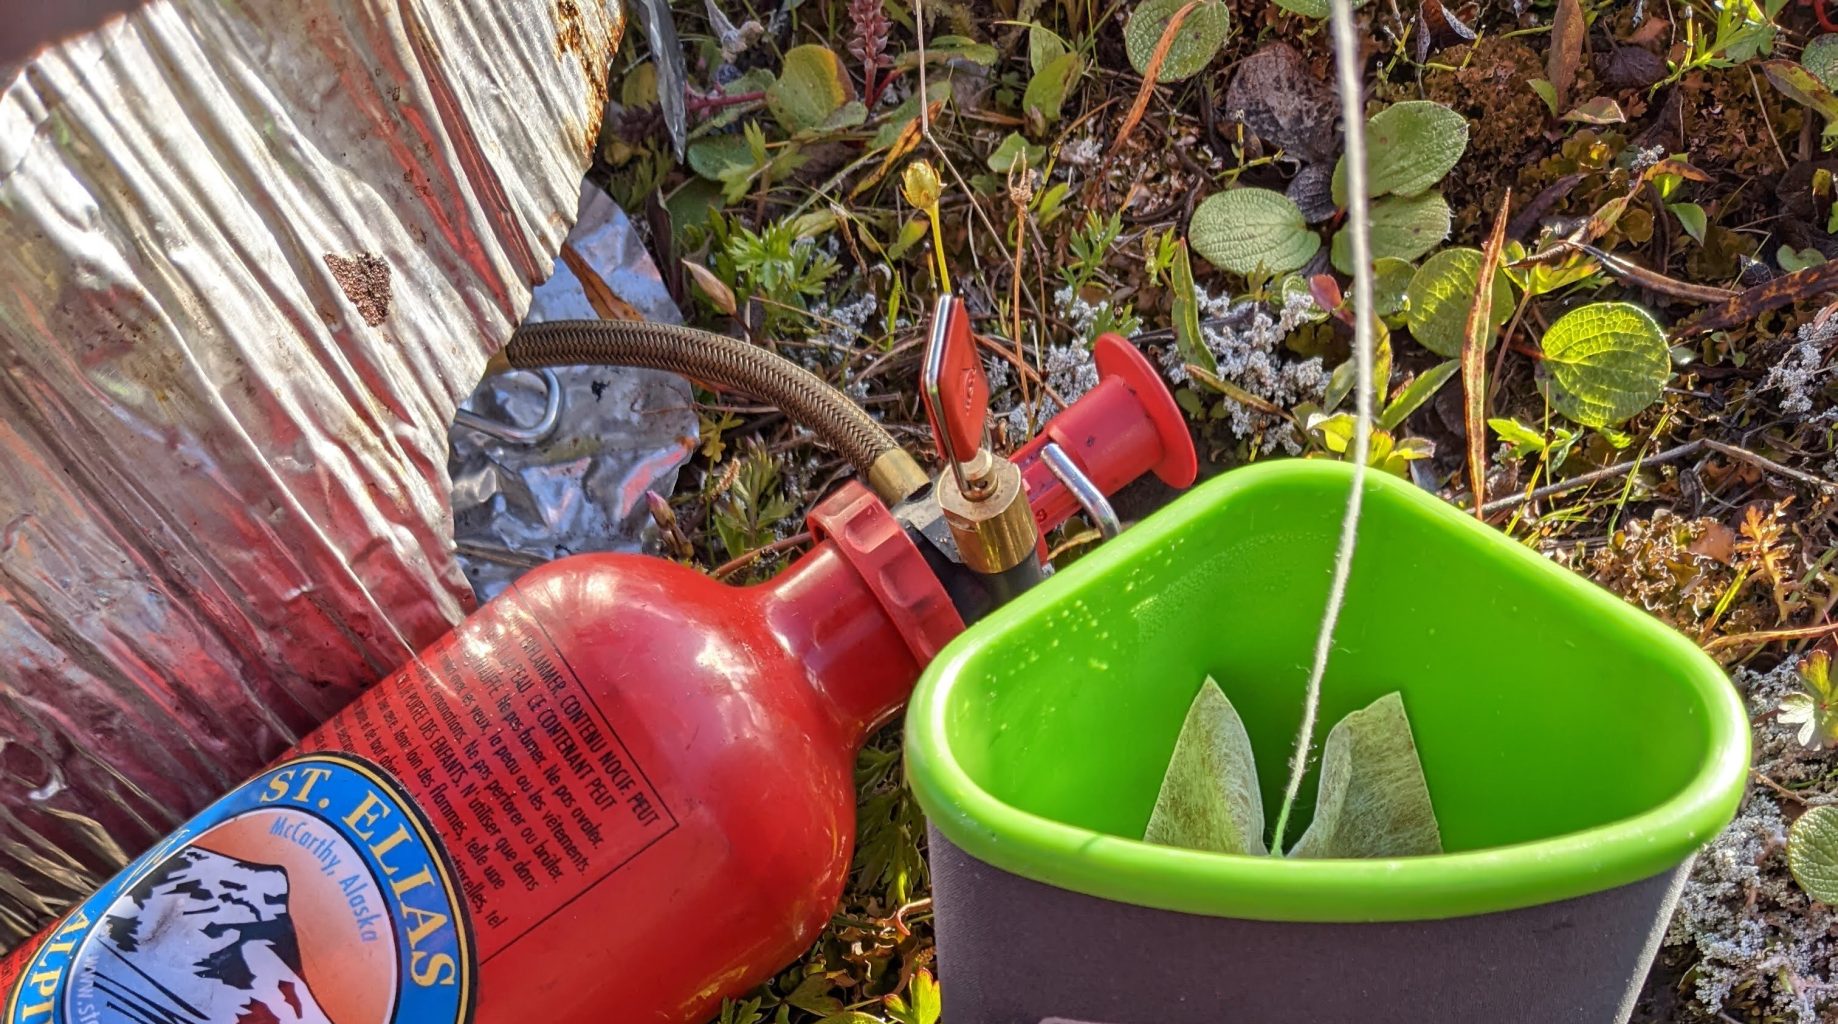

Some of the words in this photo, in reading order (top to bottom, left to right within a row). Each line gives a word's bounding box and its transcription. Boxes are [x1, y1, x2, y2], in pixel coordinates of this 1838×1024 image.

[467, 704, 492, 736] yeux,
[496, 694, 512, 712] Ne
[501, 710, 524, 732] pas
[490, 729, 504, 746] la
[510, 664, 535, 698] PEAU.
[526, 694, 546, 712] CE
[538, 709, 594, 780] CONTENANT
[586, 778, 618, 811] PEUT
[518, 726, 546, 768] fumer.
[492, 746, 522, 776] peau
[542, 764, 560, 786] Ne
[560, 694, 606, 752] CONTENU
[598, 750, 636, 795] NOCIF.
[626, 792, 660, 826] PEUT
[516, 776, 533, 792] ou
[528, 787, 546, 812] les
[552, 784, 576, 808] pas
[406, 745, 424, 770] loin
[416, 766, 435, 788] des
[428, 782, 468, 840] flammes,
[464, 836, 490, 866] telle
[484, 866, 506, 890] une
[418, 718, 440, 740] DES
[430, 736, 468, 788] ENFANTS.
[460, 782, 502, 836] N'utiliser
[494, 838, 518, 862] que
[512, 860, 540, 892] dans
[462, 738, 478, 760] Ne
[470, 760, 494, 780] pas
[484, 780, 526, 826] perforer
[520, 826, 537, 844] ou
[532, 840, 563, 883] brûler.
[542, 810, 588, 873] vêtements.
[571, 808, 604, 849] avaler.
[260, 767, 332, 809] ST.
[342, 790, 456, 987] ELIAS
[269, 816, 342, 877] McCarthy,
[339, 874, 381, 942] Alaska
[486, 910, 508, 929] tel
